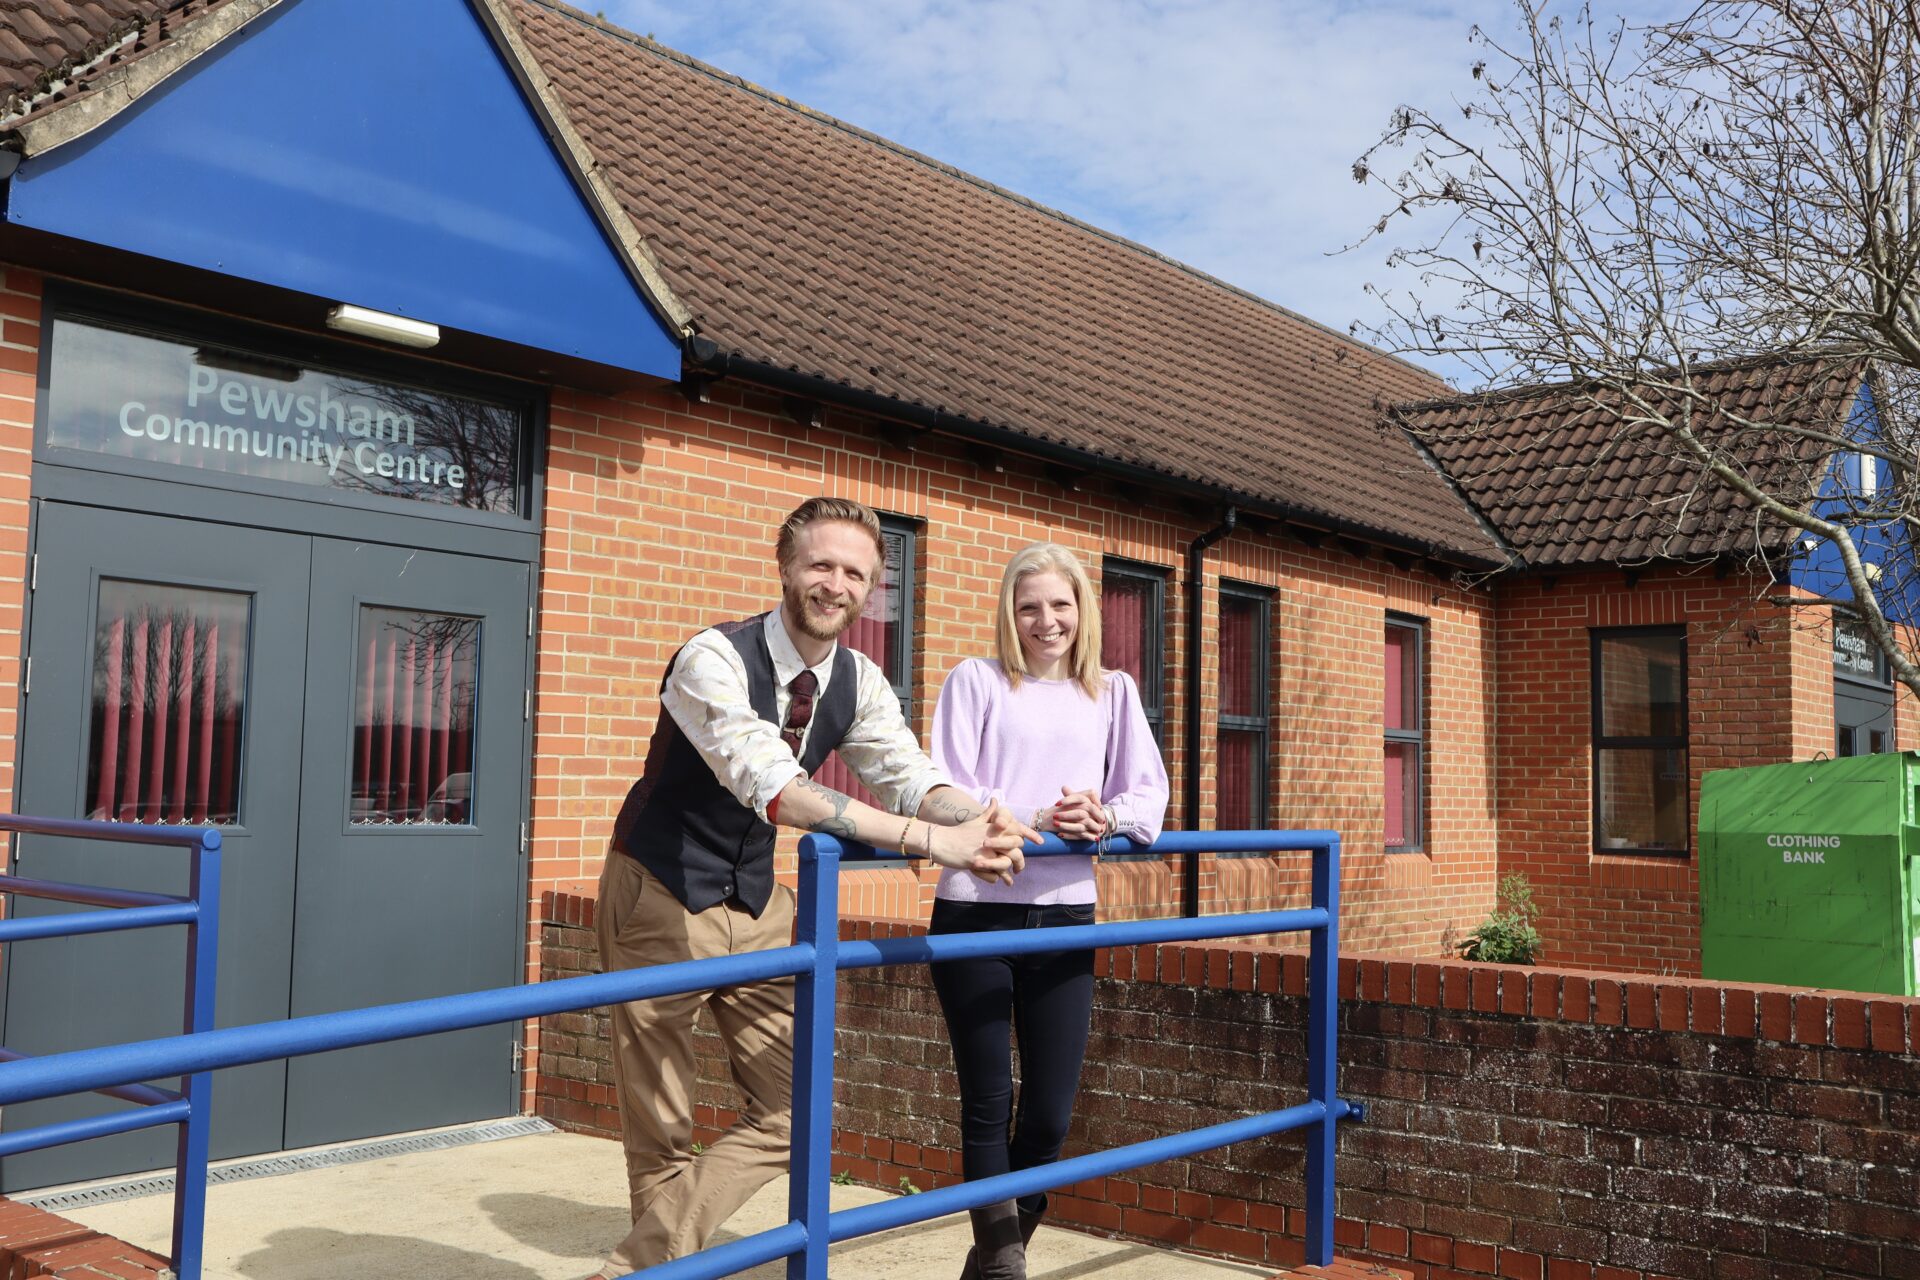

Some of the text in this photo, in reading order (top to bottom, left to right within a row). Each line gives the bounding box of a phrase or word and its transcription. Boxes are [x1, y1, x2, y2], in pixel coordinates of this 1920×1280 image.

[188, 363, 415, 446] Pewsham
[119, 401, 466, 488] Community Centre
[1835, 626, 1867, 656] Pewsham
[1766, 834, 1841, 848] CLOTHING
[1783, 850, 1826, 864] BANK
